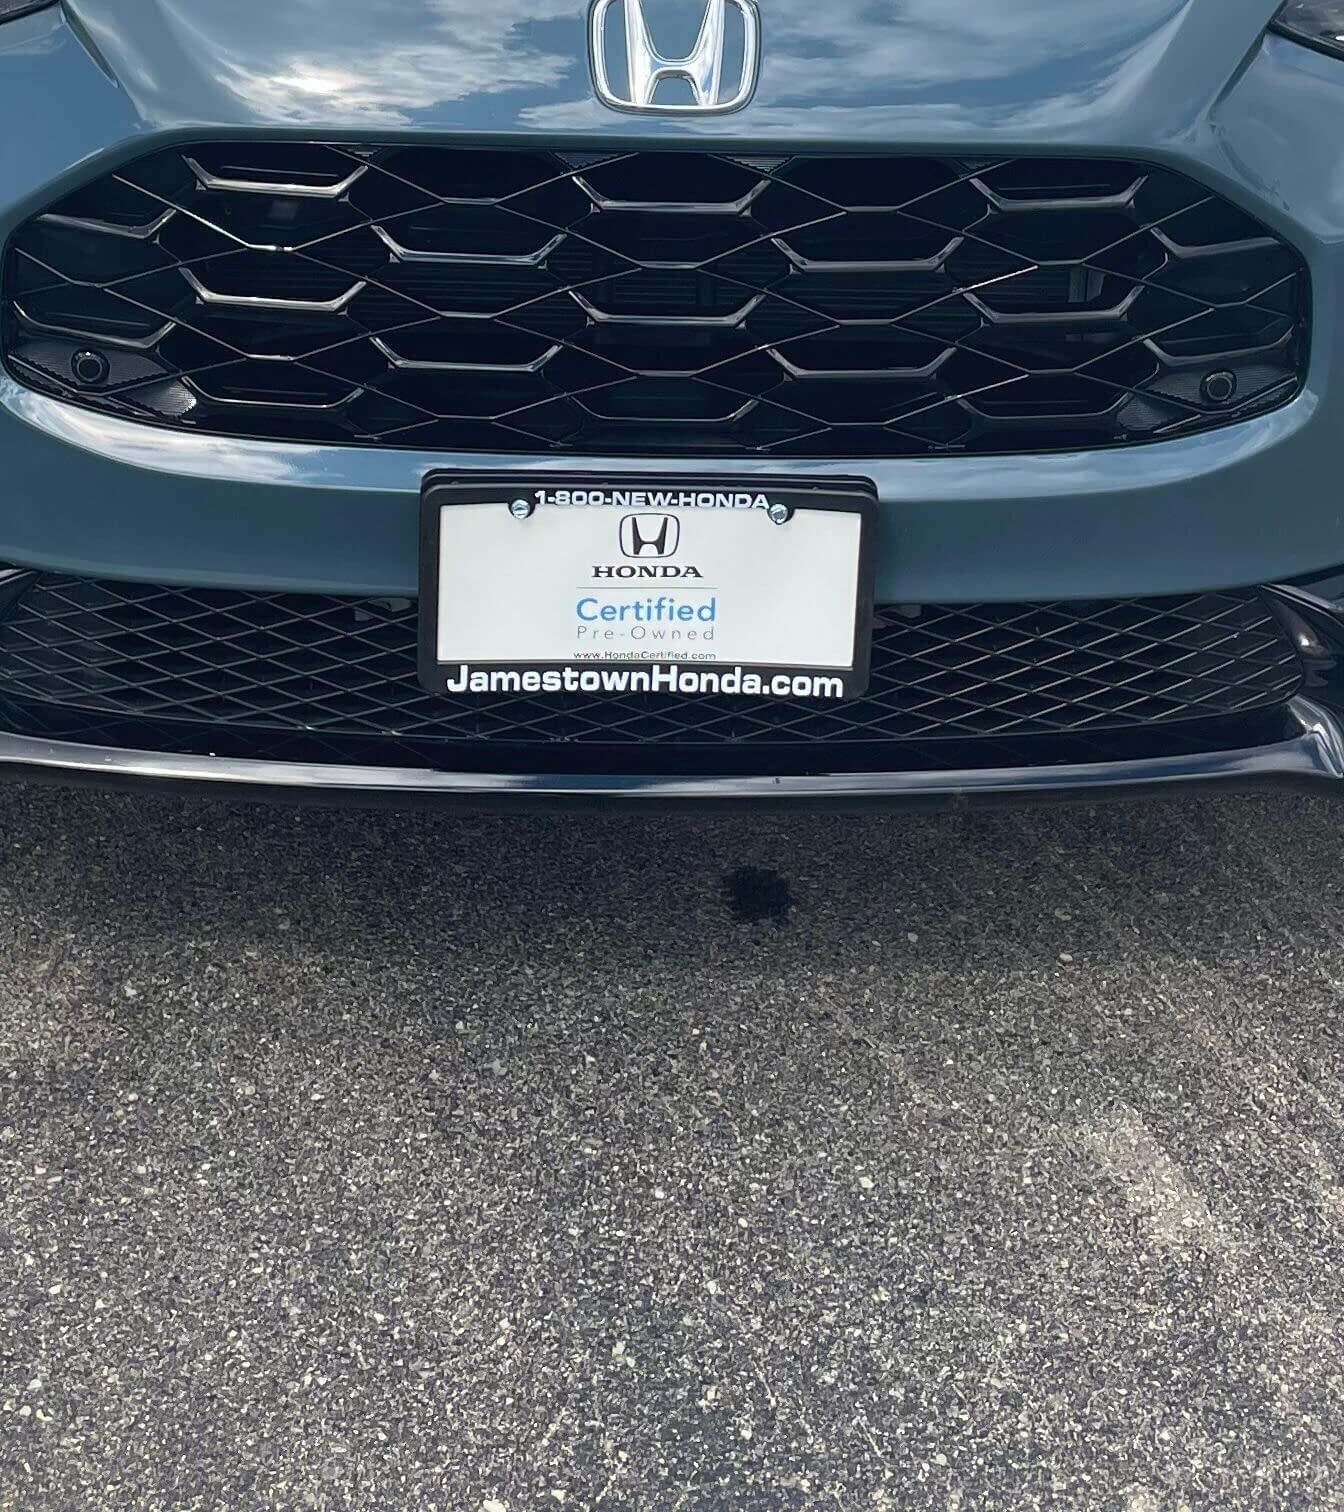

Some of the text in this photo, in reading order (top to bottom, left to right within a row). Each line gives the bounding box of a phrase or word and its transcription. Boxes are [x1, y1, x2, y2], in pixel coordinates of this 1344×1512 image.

[535, 490, 769, 508] 1-800-NEW-HONDA
[592, 565, 703, 578] HONDA
[576, 597, 716, 622] Certified
[576, 625, 714, 641] Pre-Owned
[573, 650, 716, 661] www.HondaCertified.com
[447, 664, 843, 698] JamestownHonda.com
